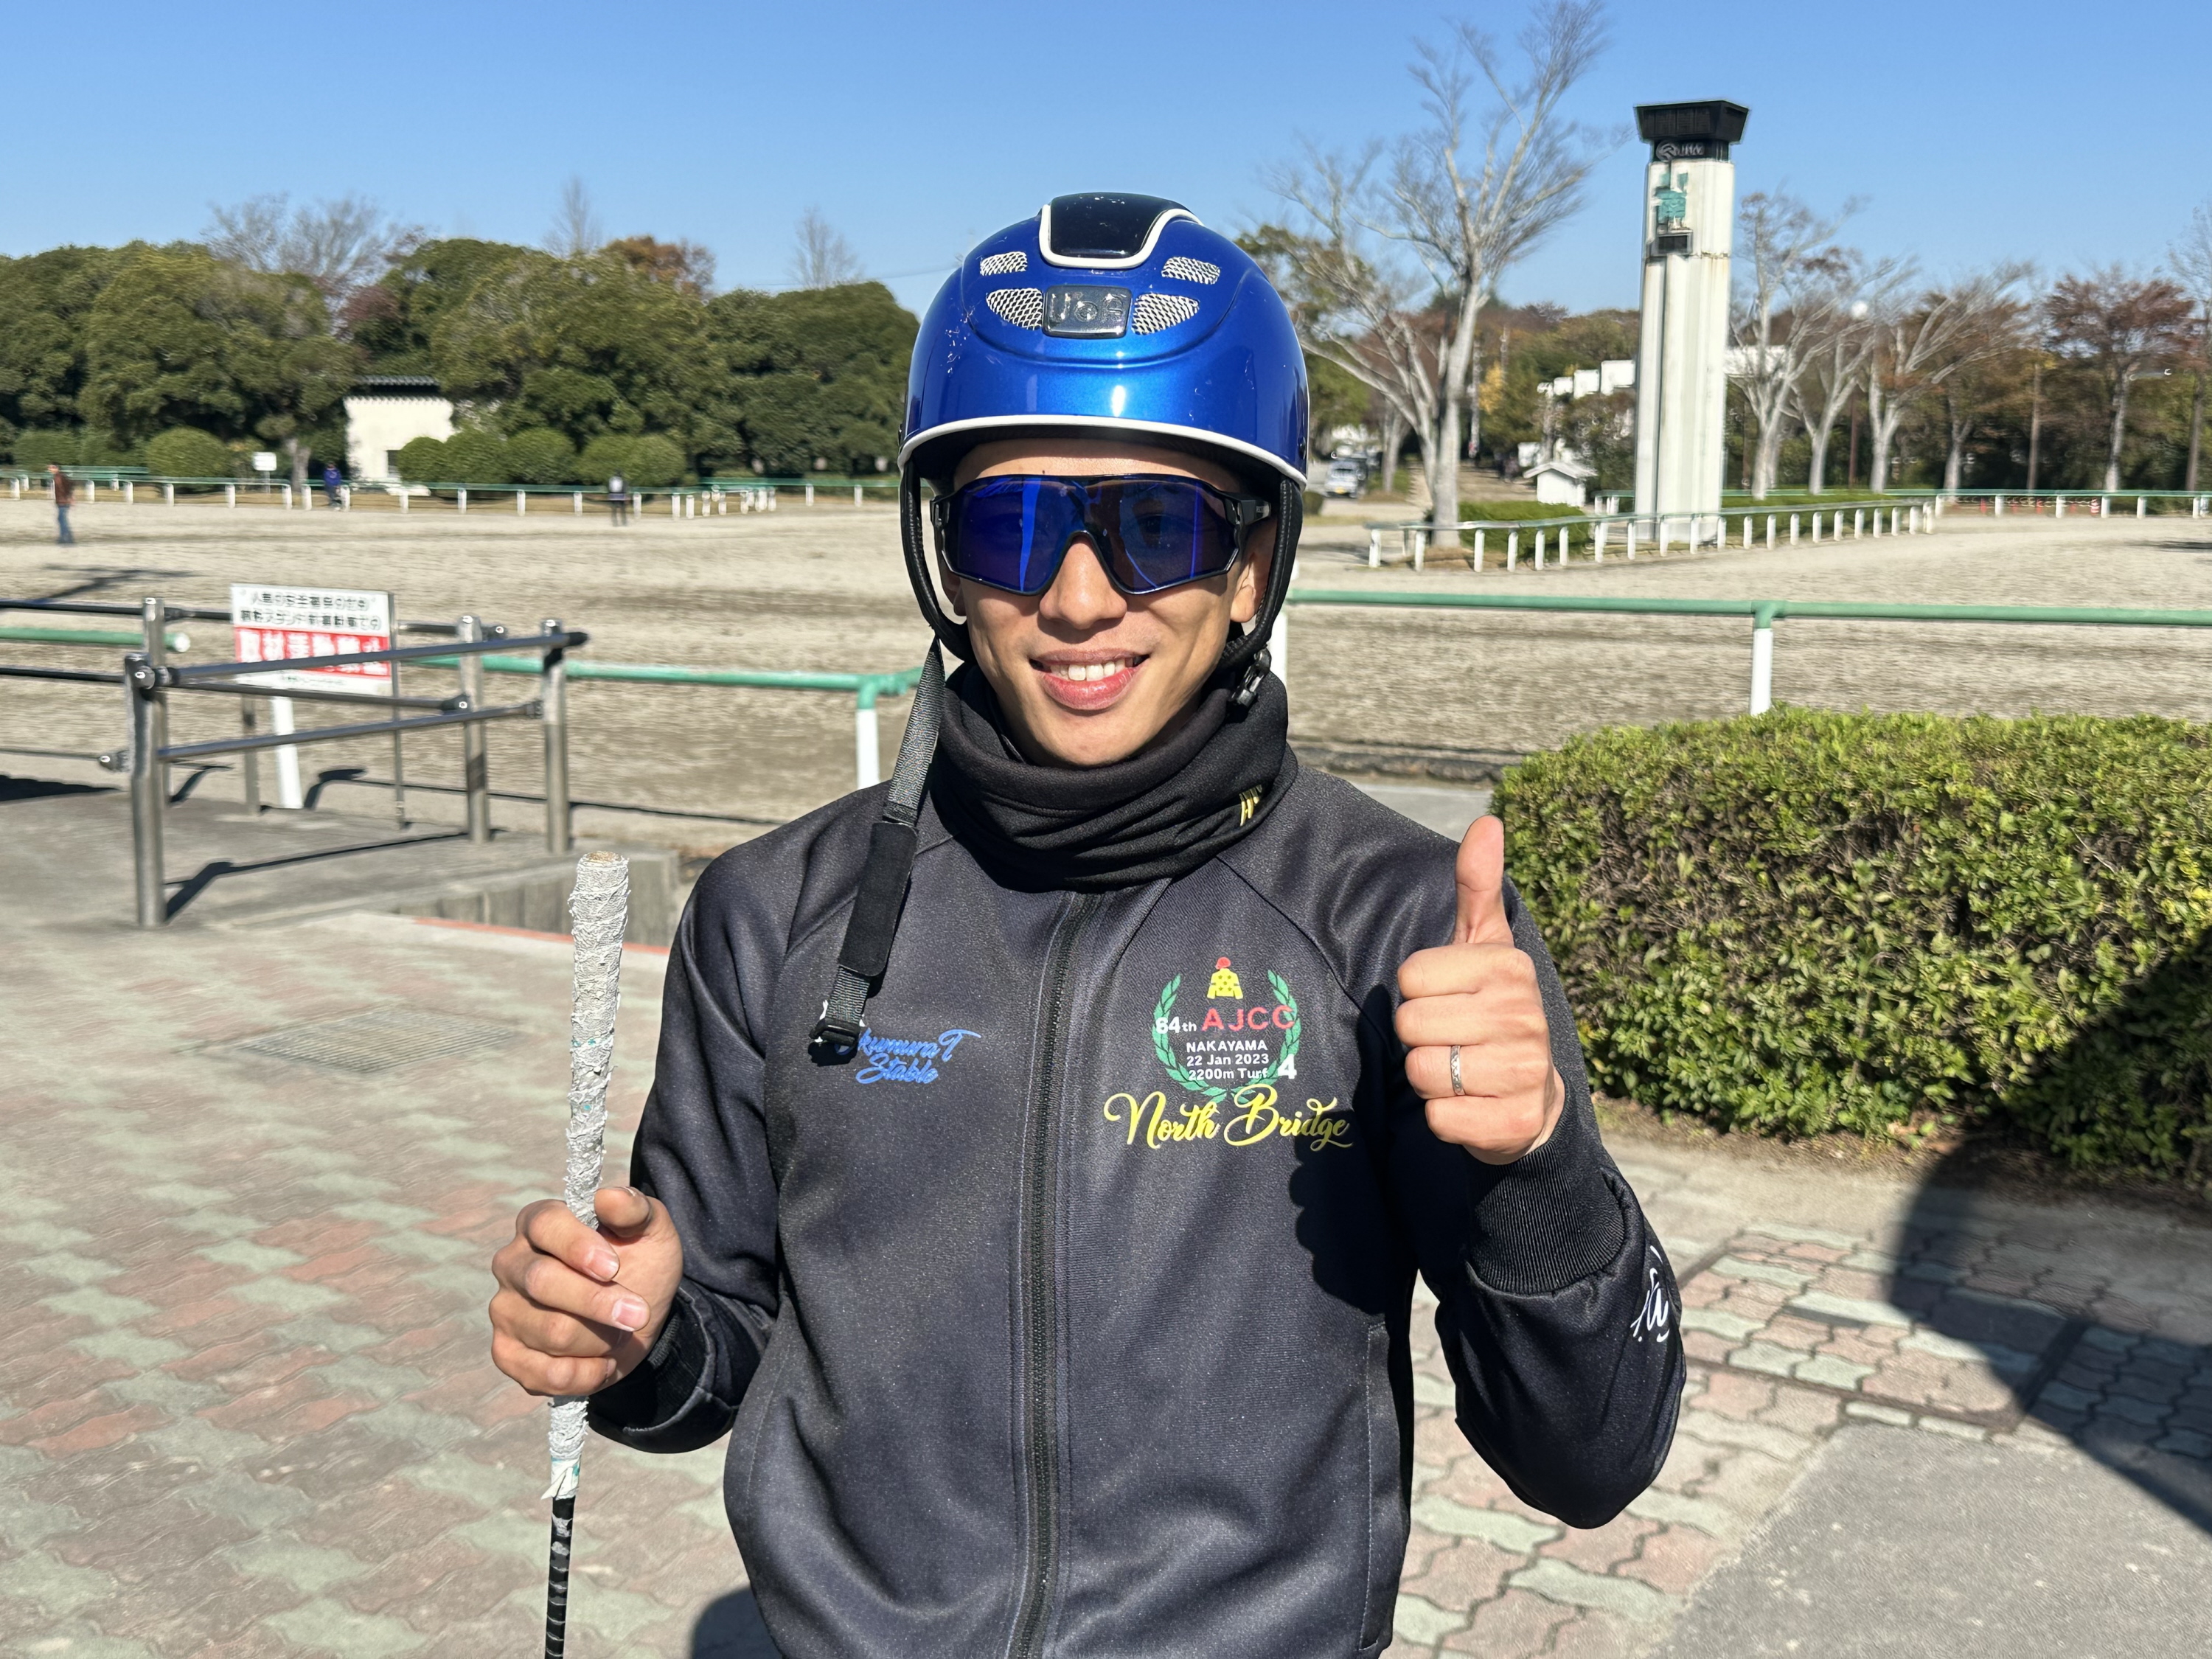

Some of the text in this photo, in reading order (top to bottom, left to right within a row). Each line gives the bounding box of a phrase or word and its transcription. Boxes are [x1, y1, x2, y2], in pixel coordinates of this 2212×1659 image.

[1155, 1005, 1295, 1034] 64th AJCC
[834, 1027, 941, 1057] kumura
[1186, 1040, 1268, 1053] NAKAYAMA
[855, 1052, 939, 1084] Stable
[1186, 1054, 1269, 1067] 22 Jan 2023
[1277, 1054, 1297, 1080] 4
[1188, 1068, 1269, 1081] 2200m Turf
[1104, 1084, 1353, 1152] North Bridge
